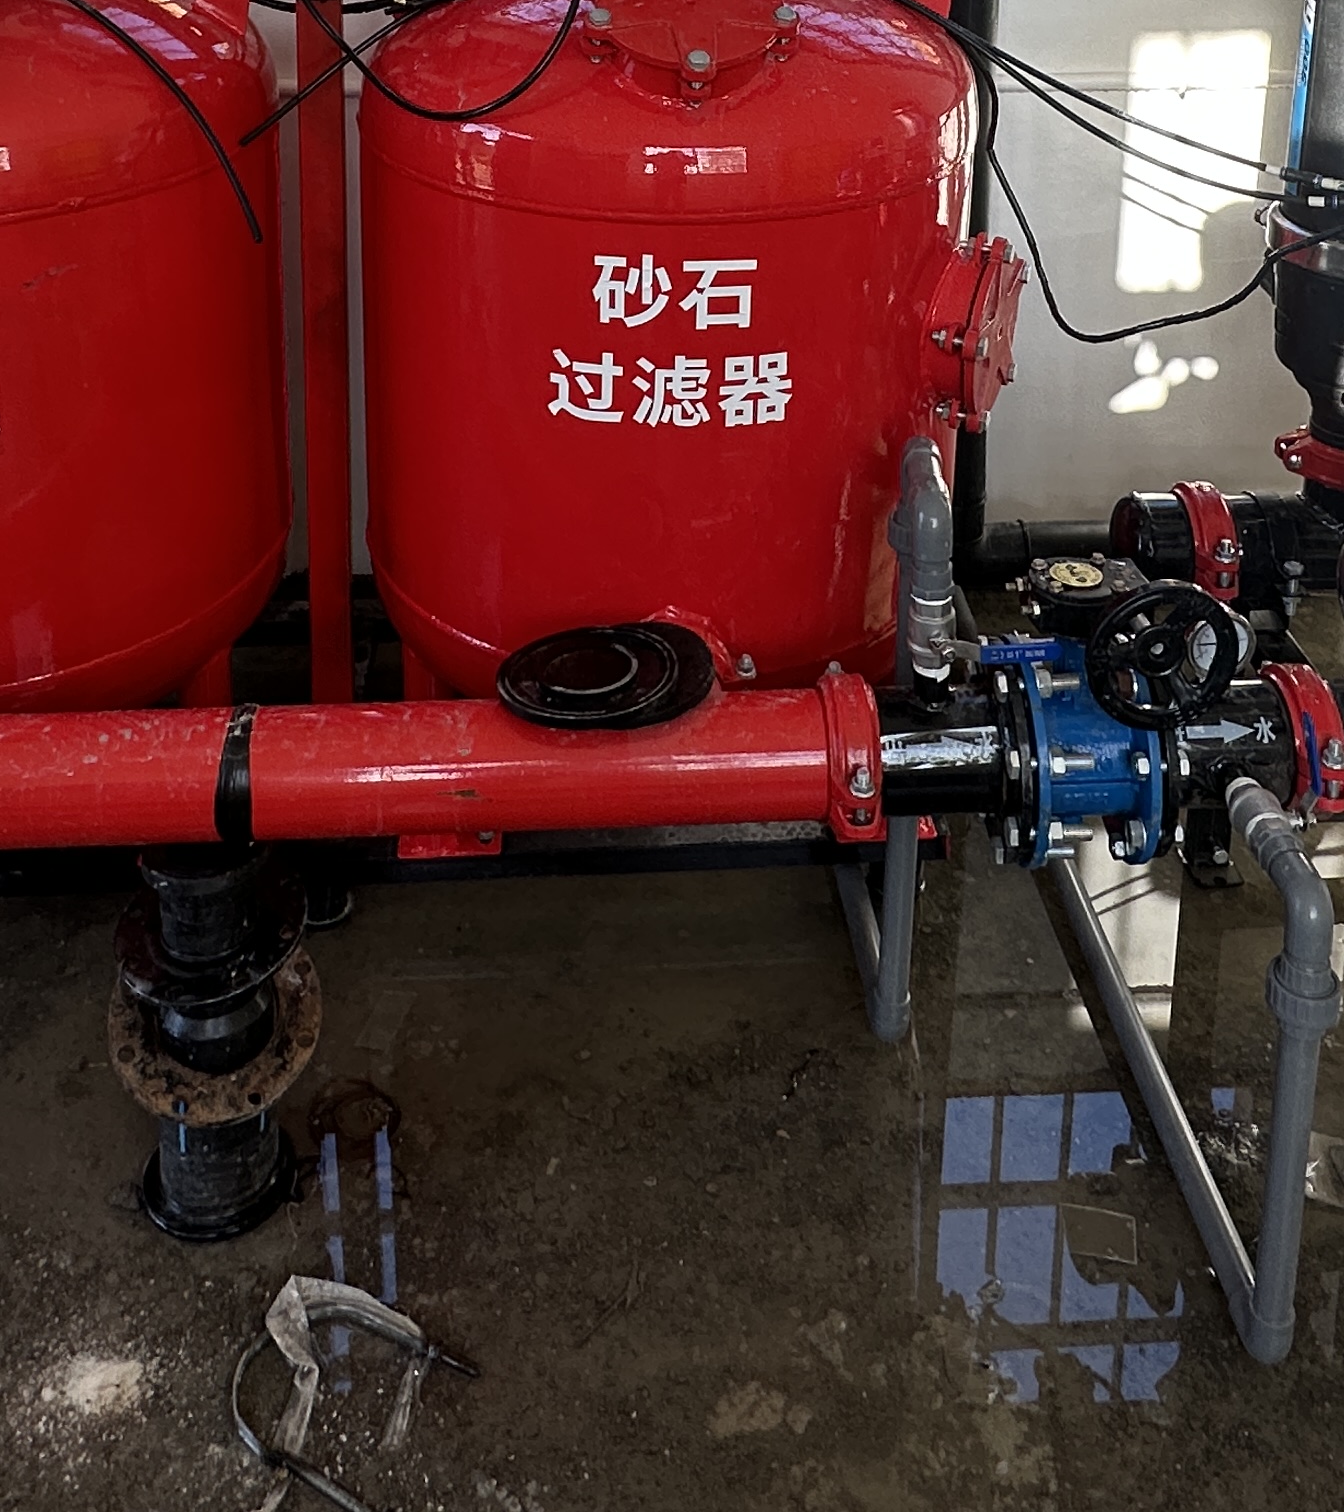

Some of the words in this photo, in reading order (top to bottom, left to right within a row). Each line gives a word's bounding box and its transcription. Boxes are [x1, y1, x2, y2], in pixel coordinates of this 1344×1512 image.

[592, 253, 758, 330] 砂石
[547, 348, 793, 428] 过滤器
